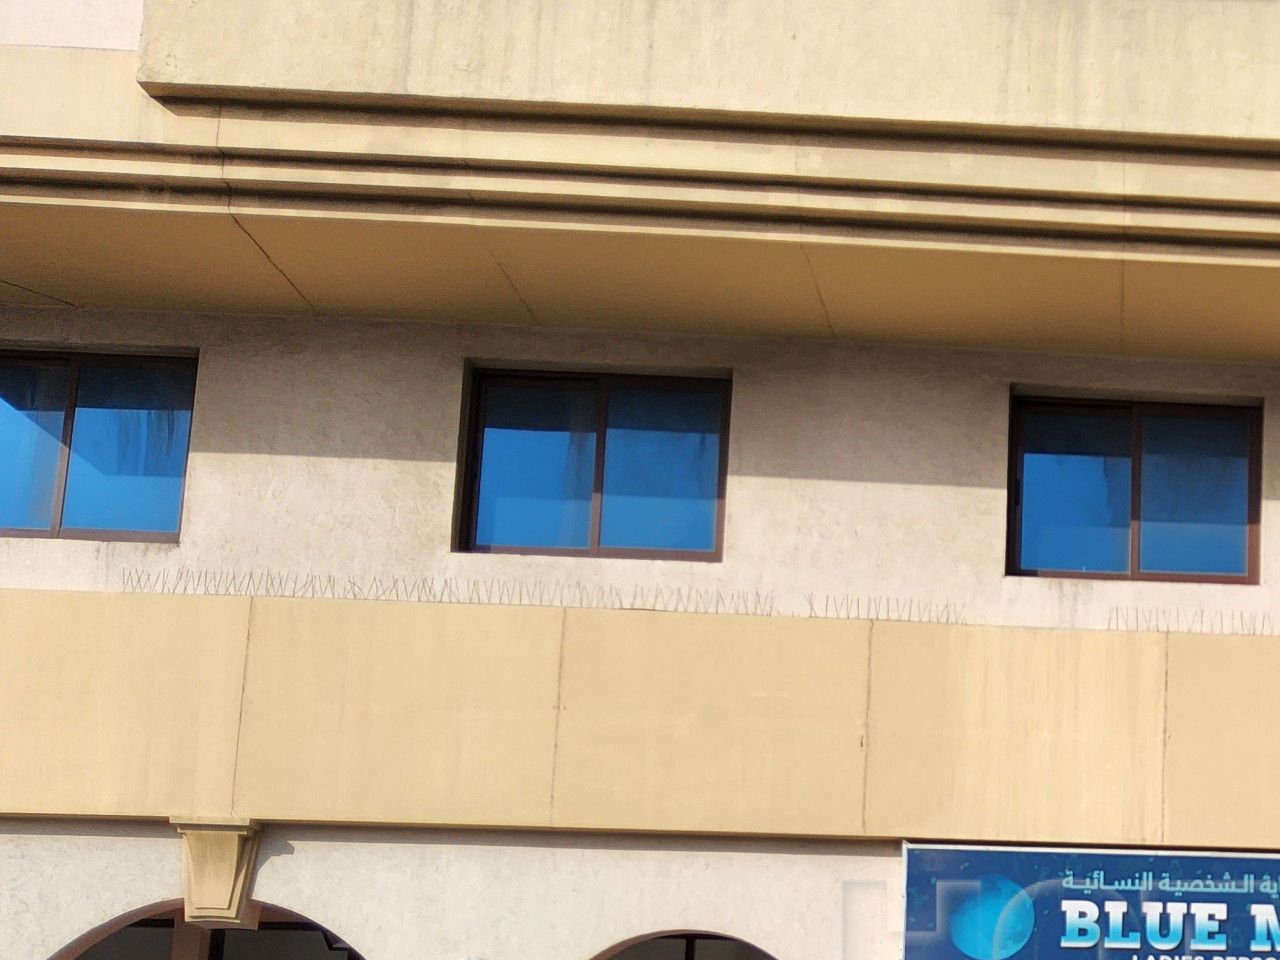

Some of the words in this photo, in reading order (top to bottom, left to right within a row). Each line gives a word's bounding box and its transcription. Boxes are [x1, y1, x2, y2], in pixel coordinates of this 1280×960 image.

[1061, 869, 1154, 894] النسائية
[1158, 871, 1255, 896] الشخصية
[1060, 899, 1228, 951] BLUE
